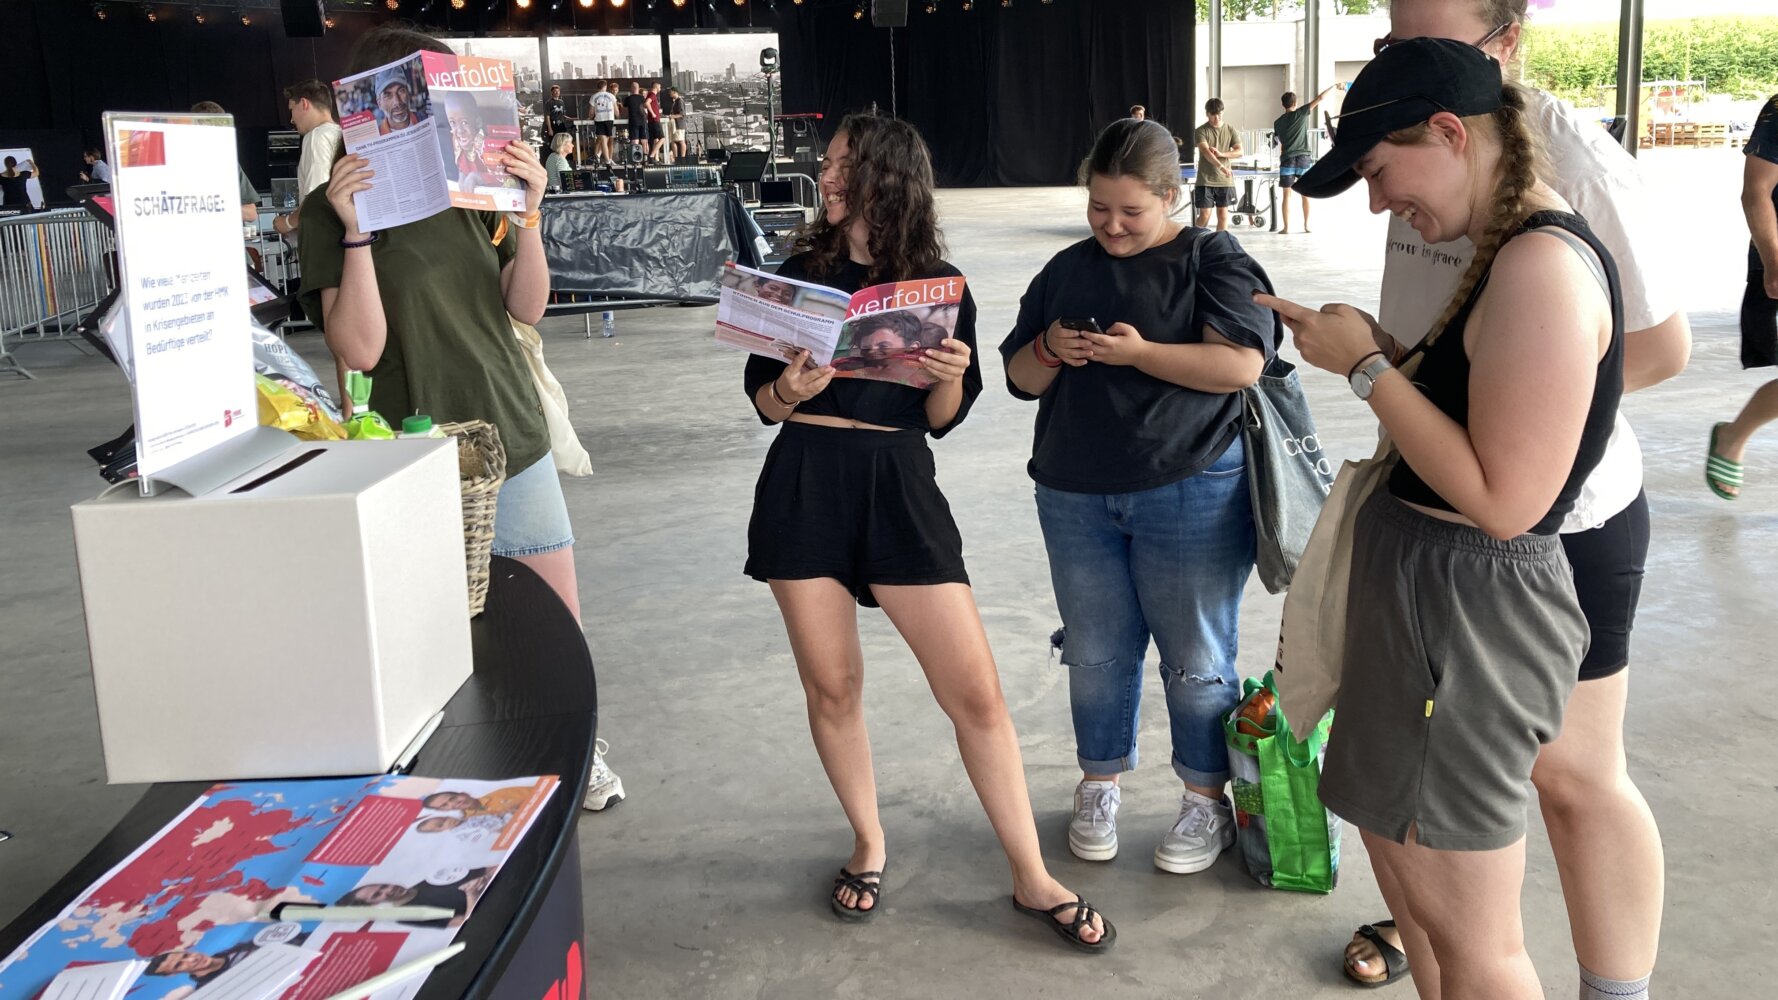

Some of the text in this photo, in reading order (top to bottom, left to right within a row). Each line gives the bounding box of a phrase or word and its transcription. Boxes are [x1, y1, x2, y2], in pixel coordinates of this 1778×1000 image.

[429, 62, 510, 88] verfolgt
[133, 190, 225, 216] SCHÄTZFRAGE:
[1433, 249, 1462, 267] grace
[140, 276, 156, 289] Wie
[143, 297, 171, 311] wurden
[203, 289, 214, 301] der
[850, 279, 957, 315] verfolgt
[145, 311, 215, 333] in Krisengebieten an
[146, 337, 185, 355] Bedürftige
